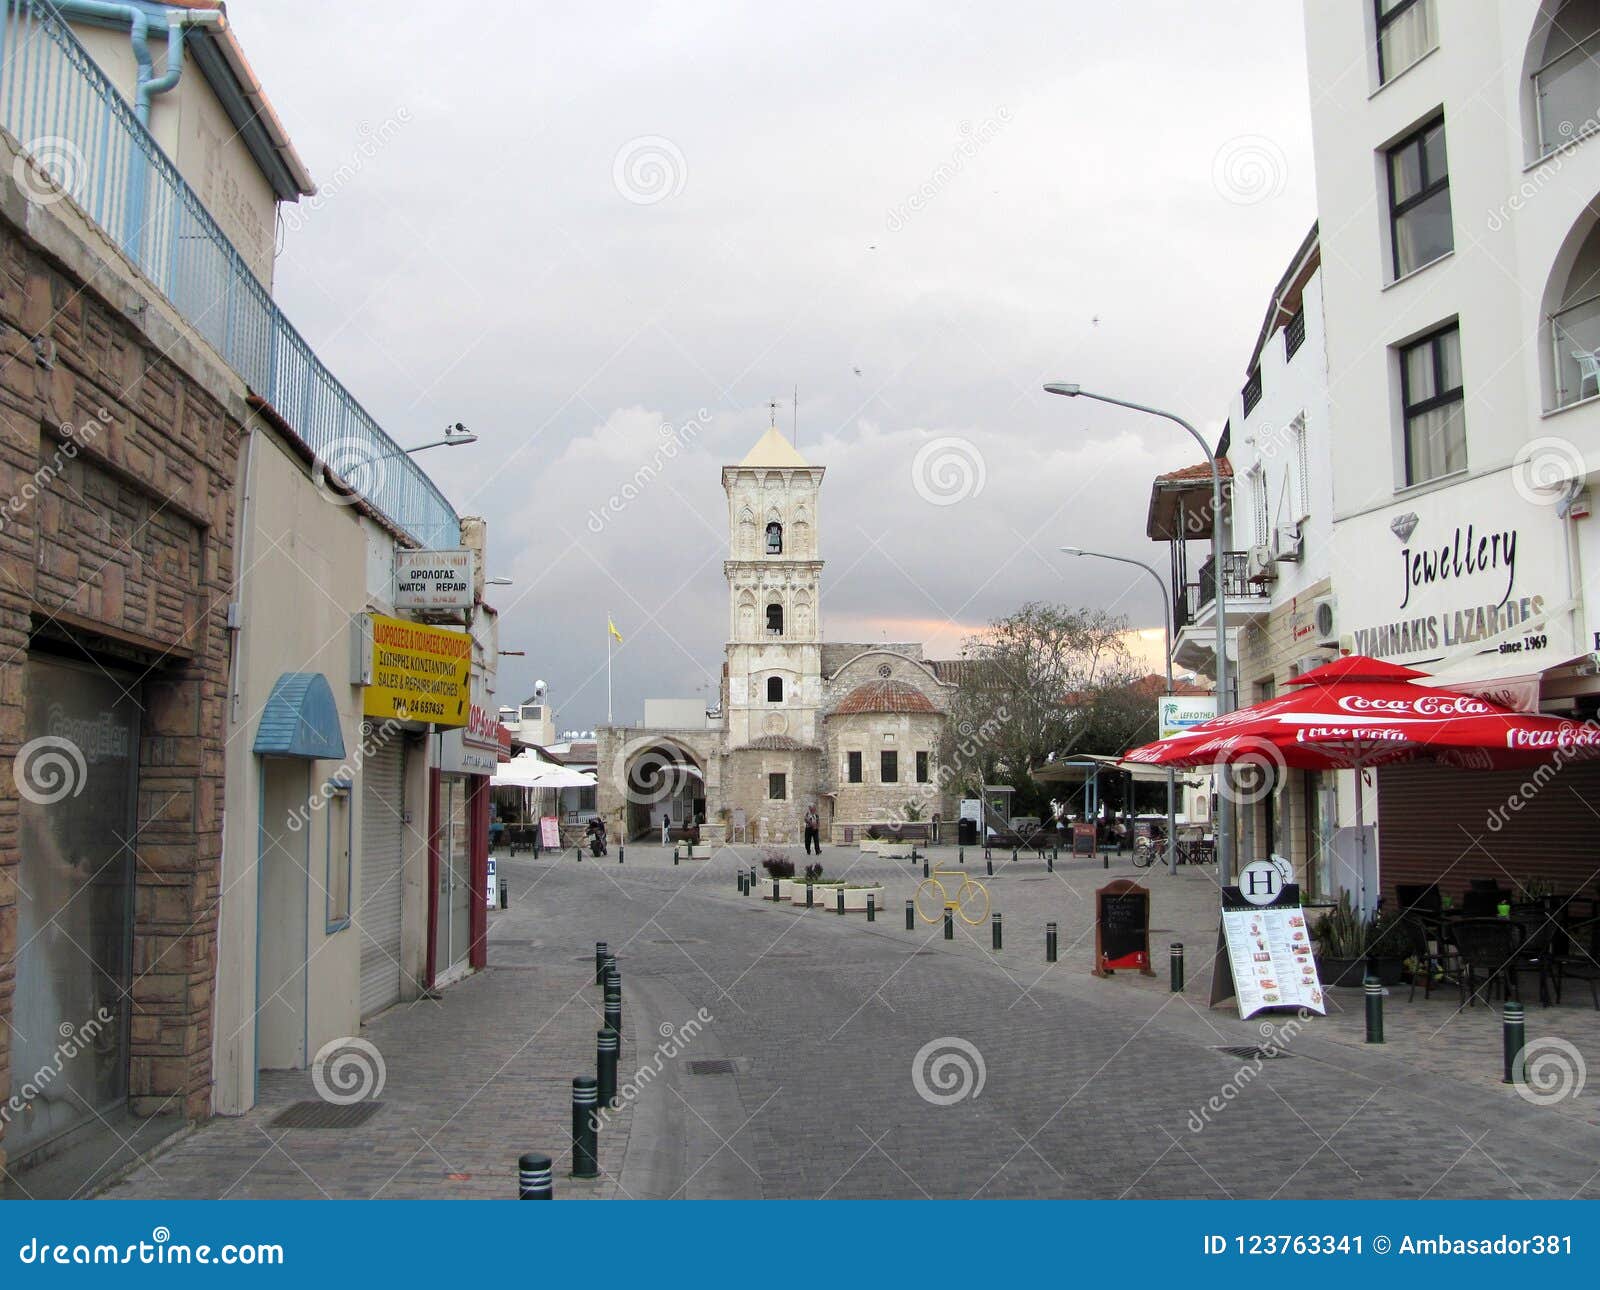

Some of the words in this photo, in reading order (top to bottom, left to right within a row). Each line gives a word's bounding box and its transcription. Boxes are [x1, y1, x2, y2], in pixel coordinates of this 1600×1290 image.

[410, 569, 455, 579] ΩΡΟΛΟΓΑΣ
[399, 582, 426, 592] WATCH
[436, 582, 467, 592] REPAIR
[1354, 615, 1438, 658] YIANNAKIS
[1499, 640, 1522, 654] since
[1524, 635, 1548, 650] 1969
[379, 650, 409, 669] ΣΩΤΗΡΗΣ
[378, 671, 399, 689] SALES
[405, 675, 430, 693] REPAIRS
[431, 680, 458, 696] WATCHES
[410, 700, 419, 712] 24
[420, 700, 445, 715] 657432
[1338, 695, 1488, 714] Coca-Cola
[1245, 870, 1276, 895] H
